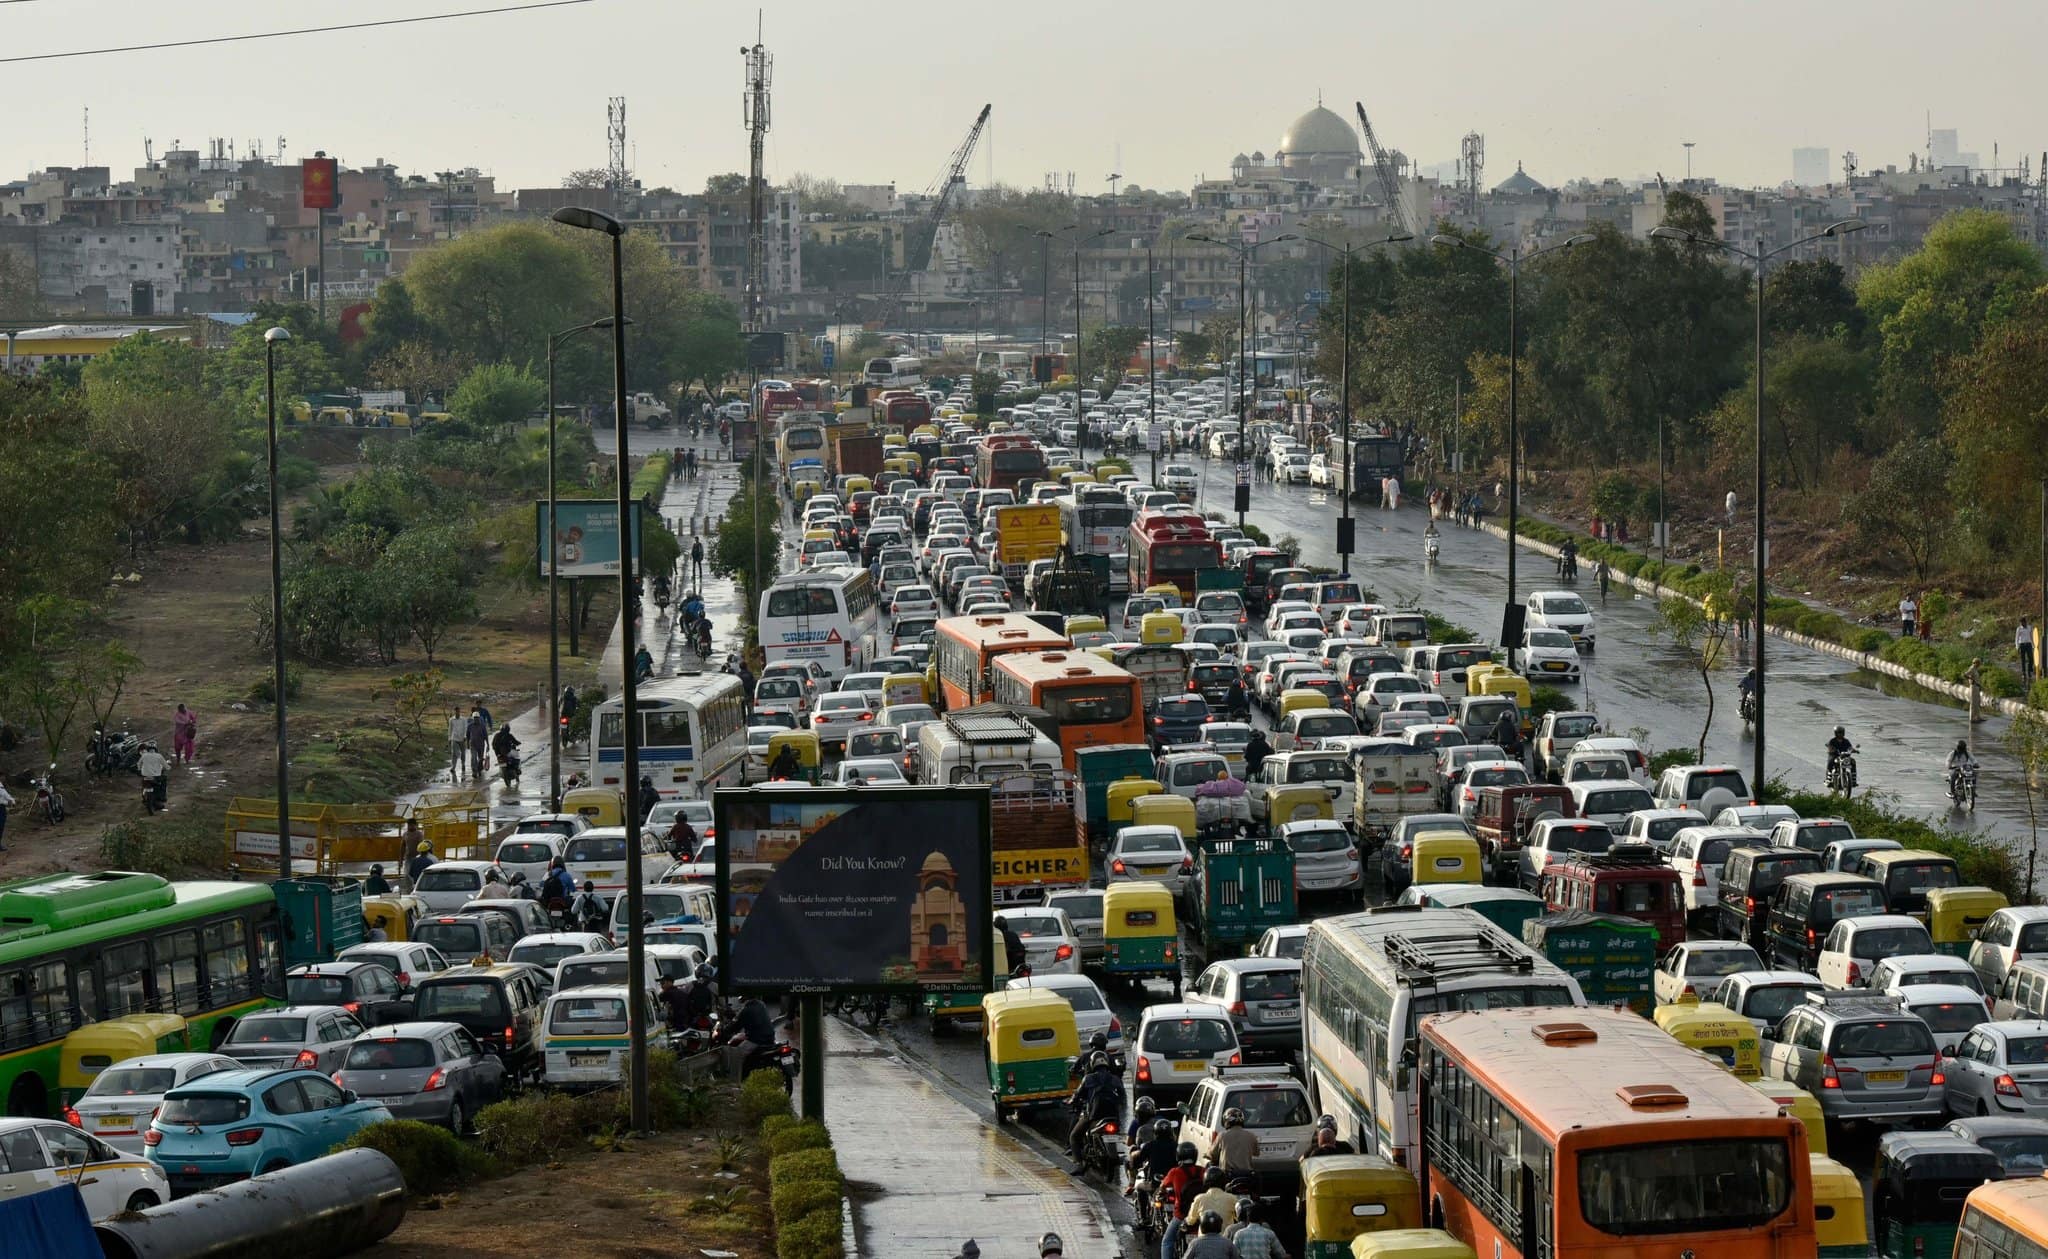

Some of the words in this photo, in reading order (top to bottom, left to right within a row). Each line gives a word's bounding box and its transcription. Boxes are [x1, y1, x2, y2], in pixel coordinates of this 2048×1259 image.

[822, 856, 842, 870] Did
[845, 857, 865, 870] You
[868, 856, 906, 870] Know?
[992, 858, 1068, 875] EICHER
[790, 983, 832, 993] JCDecaux
[930, 983, 951, 991] Delhi
[953, 983, 984, 991] Tourism
